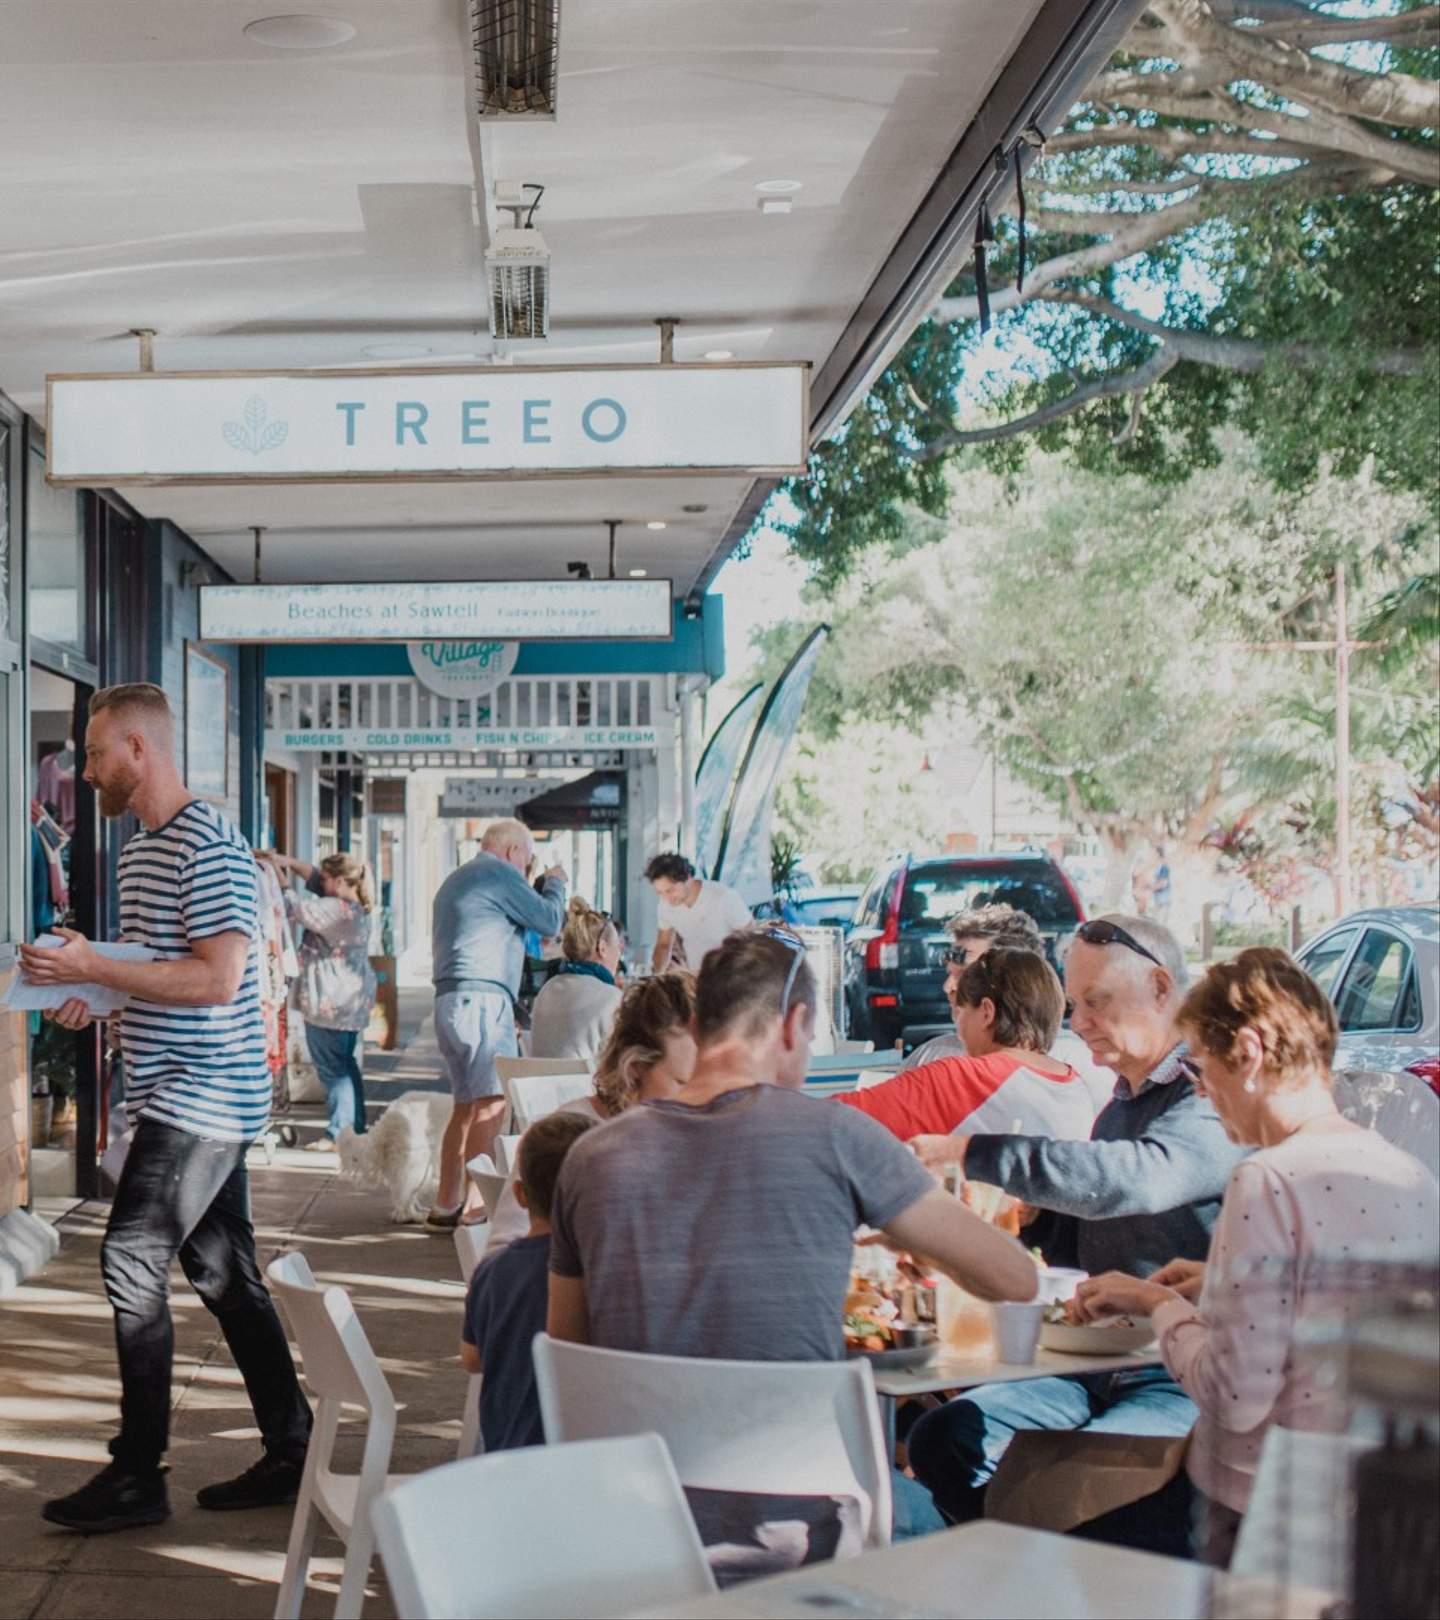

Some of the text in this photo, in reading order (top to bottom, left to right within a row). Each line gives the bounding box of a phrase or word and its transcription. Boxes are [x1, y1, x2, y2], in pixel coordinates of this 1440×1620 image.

[336, 397, 627, 446] TREEO
[287, 602, 373, 619] Beaches
[380, 603, 400, 618] at
[407, 602, 480, 619] Sawtell
[284, 733, 345, 746] BURGERS
[366, 733, 400, 745] COLD
[404, 732, 452, 745] DRINKS
[475, 732, 506, 744] FISH
[509, 732, 519, 744] N
[584, 731, 605, 743] ICE
[608, 731, 655, 743] CREAM
